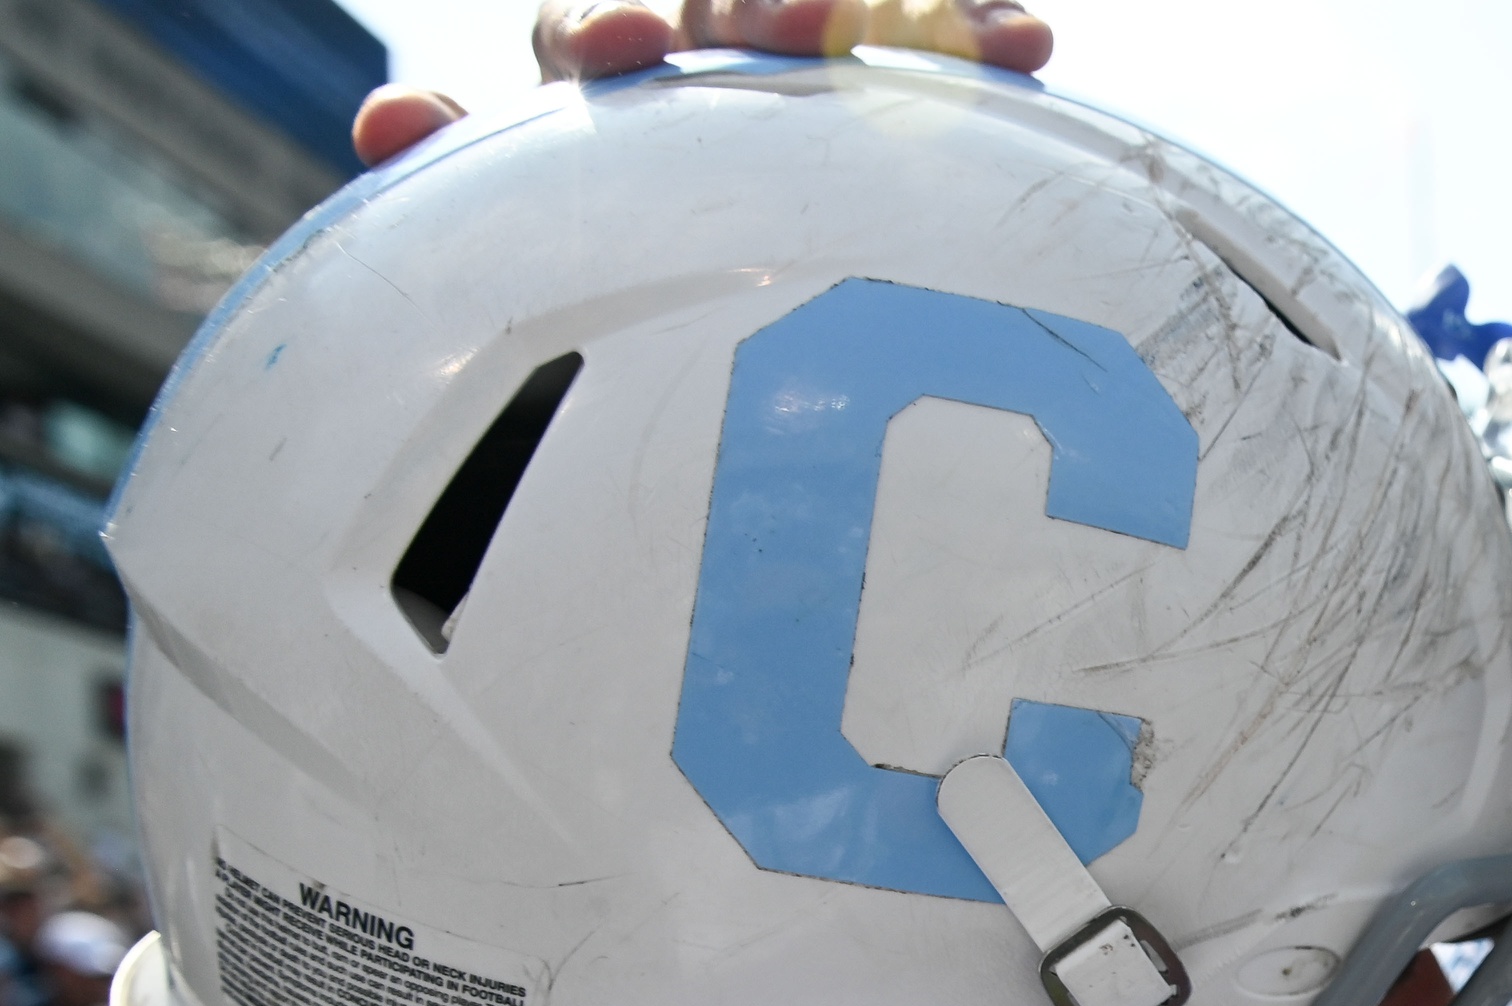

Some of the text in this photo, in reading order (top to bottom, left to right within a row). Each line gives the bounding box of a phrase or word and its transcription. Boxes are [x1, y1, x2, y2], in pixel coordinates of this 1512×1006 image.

[282, 896, 325, 929] PREVENT
[329, 921, 375, 950] SERIOUS
[377, 942, 409, 963] HEAD
[412, 955, 429, 970] OR
[433, 961, 466, 981] NECK
[469, 972, 525, 998] INJURIES
[299, 883, 415, 950] WARNING
[282, 910, 323, 940] RECEIVE
[325, 933, 357, 956] WHILE
[360, 948, 443, 987] PARTICIPATING
[446, 979, 458, 992] IN
[310, 951, 324, 966] and
[327, 959, 346, 976] such
[349, 970, 365, 984] use
[367, 977, 385, 992] can
[386, 984, 413, 1002] result
[415, 994, 423, 1006] in
[331, 949, 348, 964] ram
[350, 958, 359, 969] or
[361, 963, 388, 982] spear
[389, 973, 401, 986] an
[404, 979, 448, 1003] opposing
[329, 972, 345, 987] and
[346, 979, 383, 1004] possible
